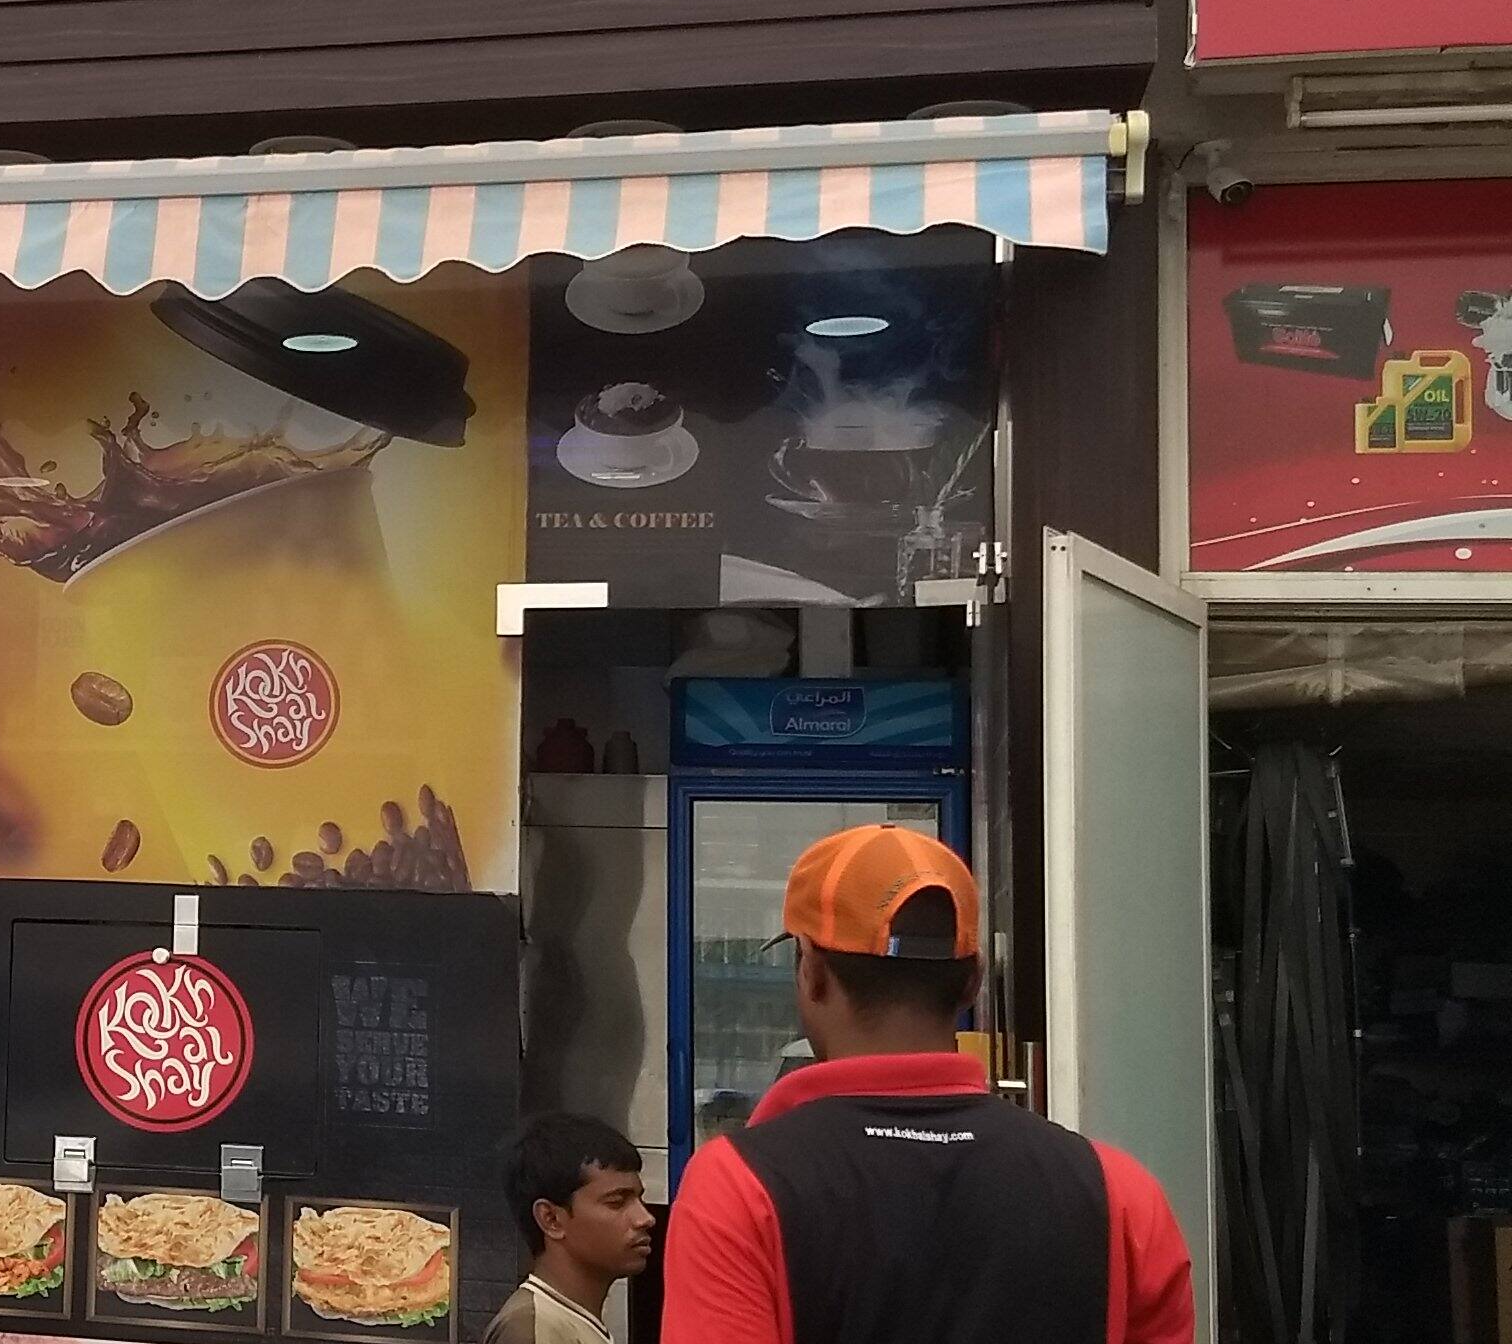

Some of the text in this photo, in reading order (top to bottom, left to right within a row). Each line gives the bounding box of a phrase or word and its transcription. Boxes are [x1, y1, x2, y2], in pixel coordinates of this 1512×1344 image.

[1424, 389, 1451, 403] OIL
[535, 512, 715, 530] TEA & COFFEE
[231, 711, 313, 754] Shay
[784, 716, 851, 732] Almarai
[105, 1048, 217, 1111] Shay
